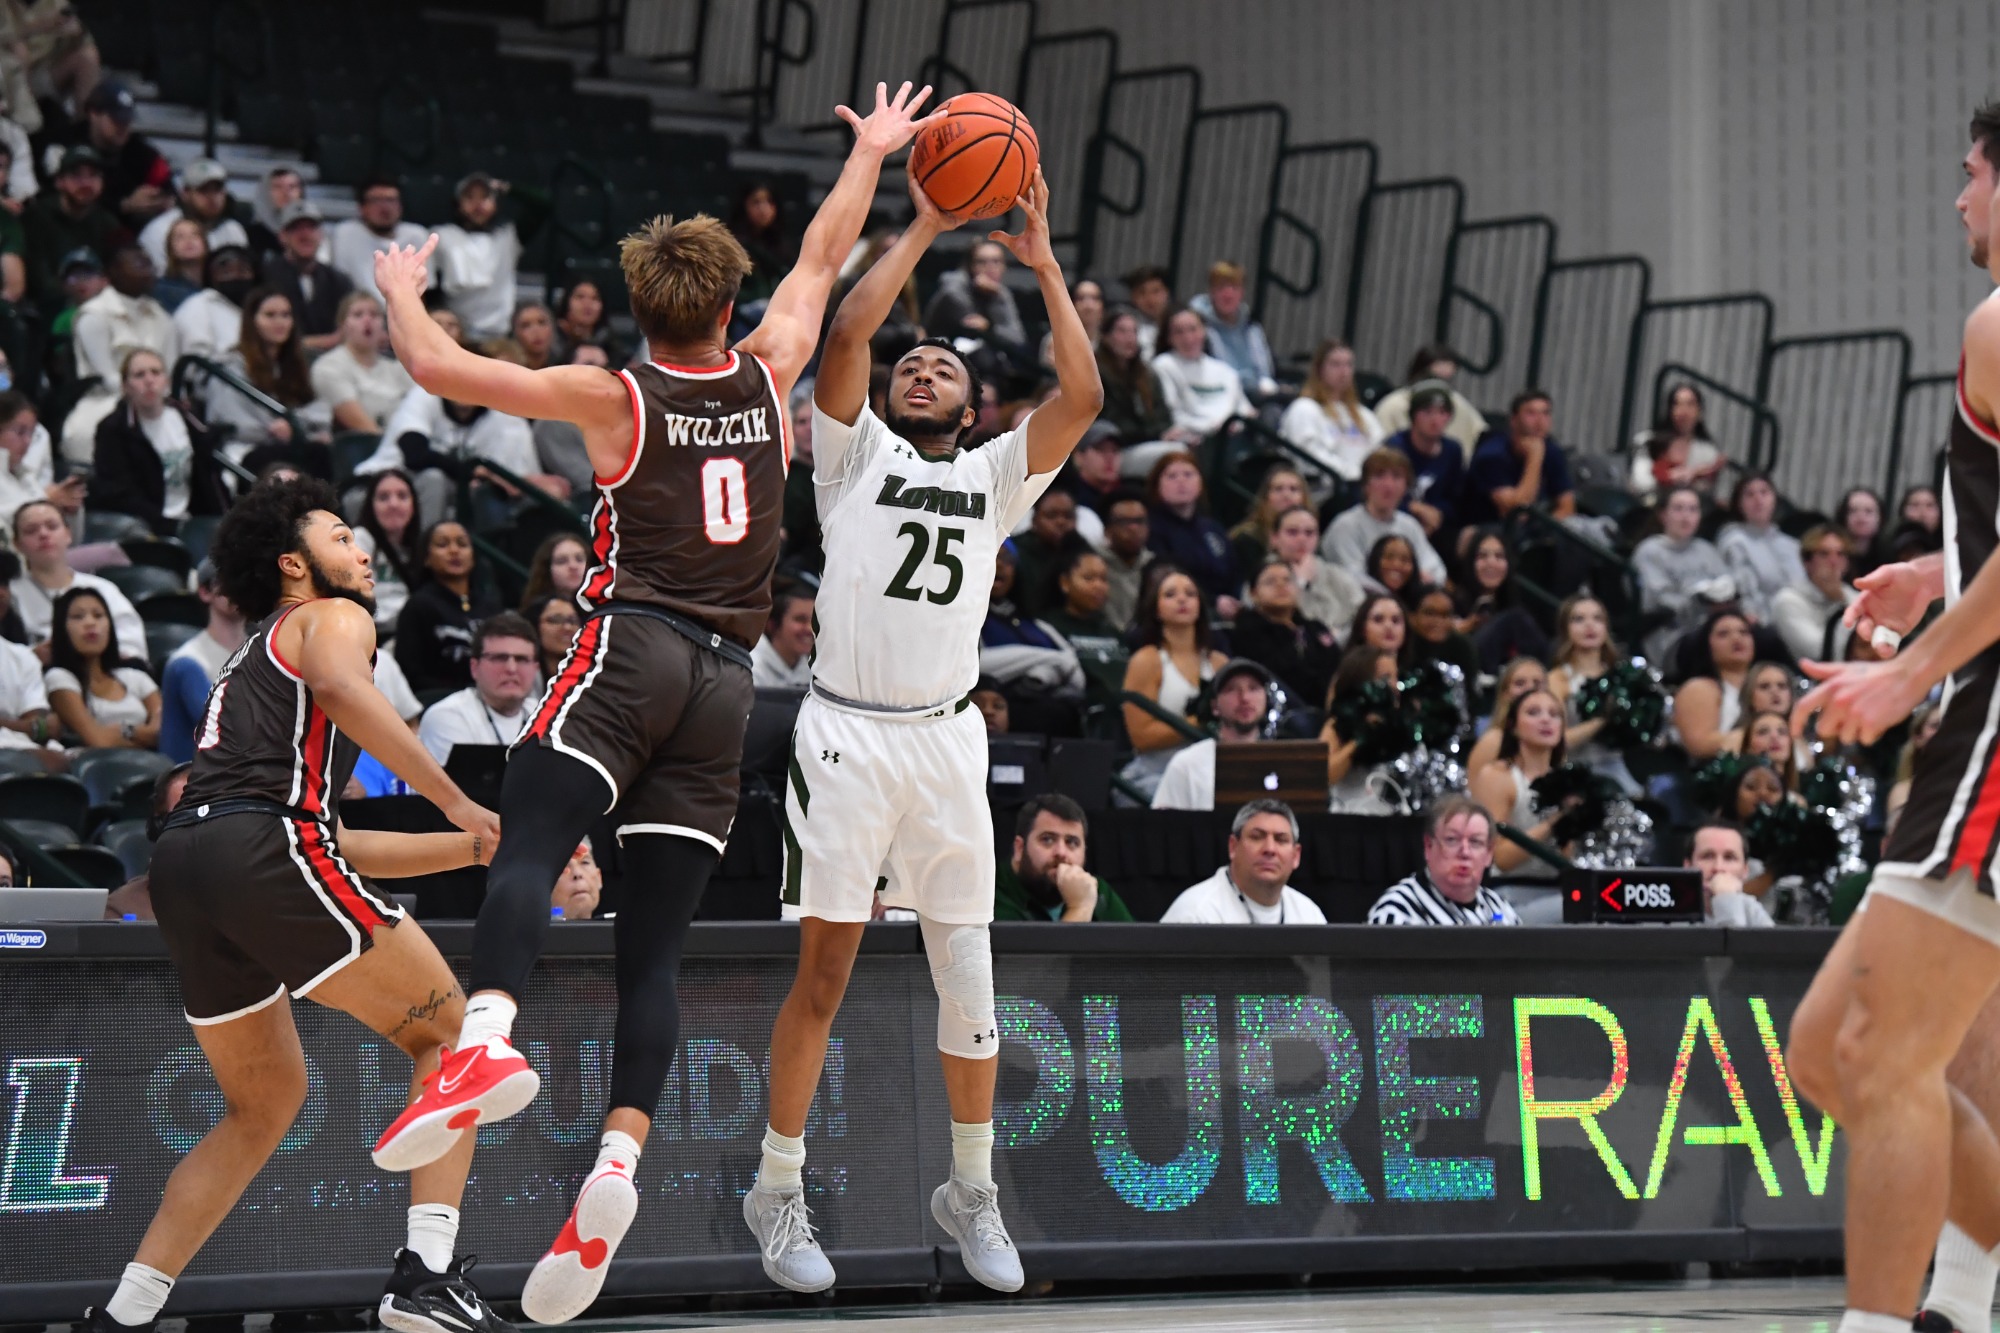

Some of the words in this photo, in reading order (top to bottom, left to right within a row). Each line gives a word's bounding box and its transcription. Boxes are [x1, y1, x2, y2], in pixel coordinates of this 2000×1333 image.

[931, 121, 966, 154] THE
[665, 407, 771, 447] WOJCIK
[701, 456, 750, 545] 0
[875, 474, 987, 520] LOYOLA
[883, 521, 966, 606] 25
[1624, 883, 1675, 907] POSS.
[6, 933, 42, 945] Wagner
